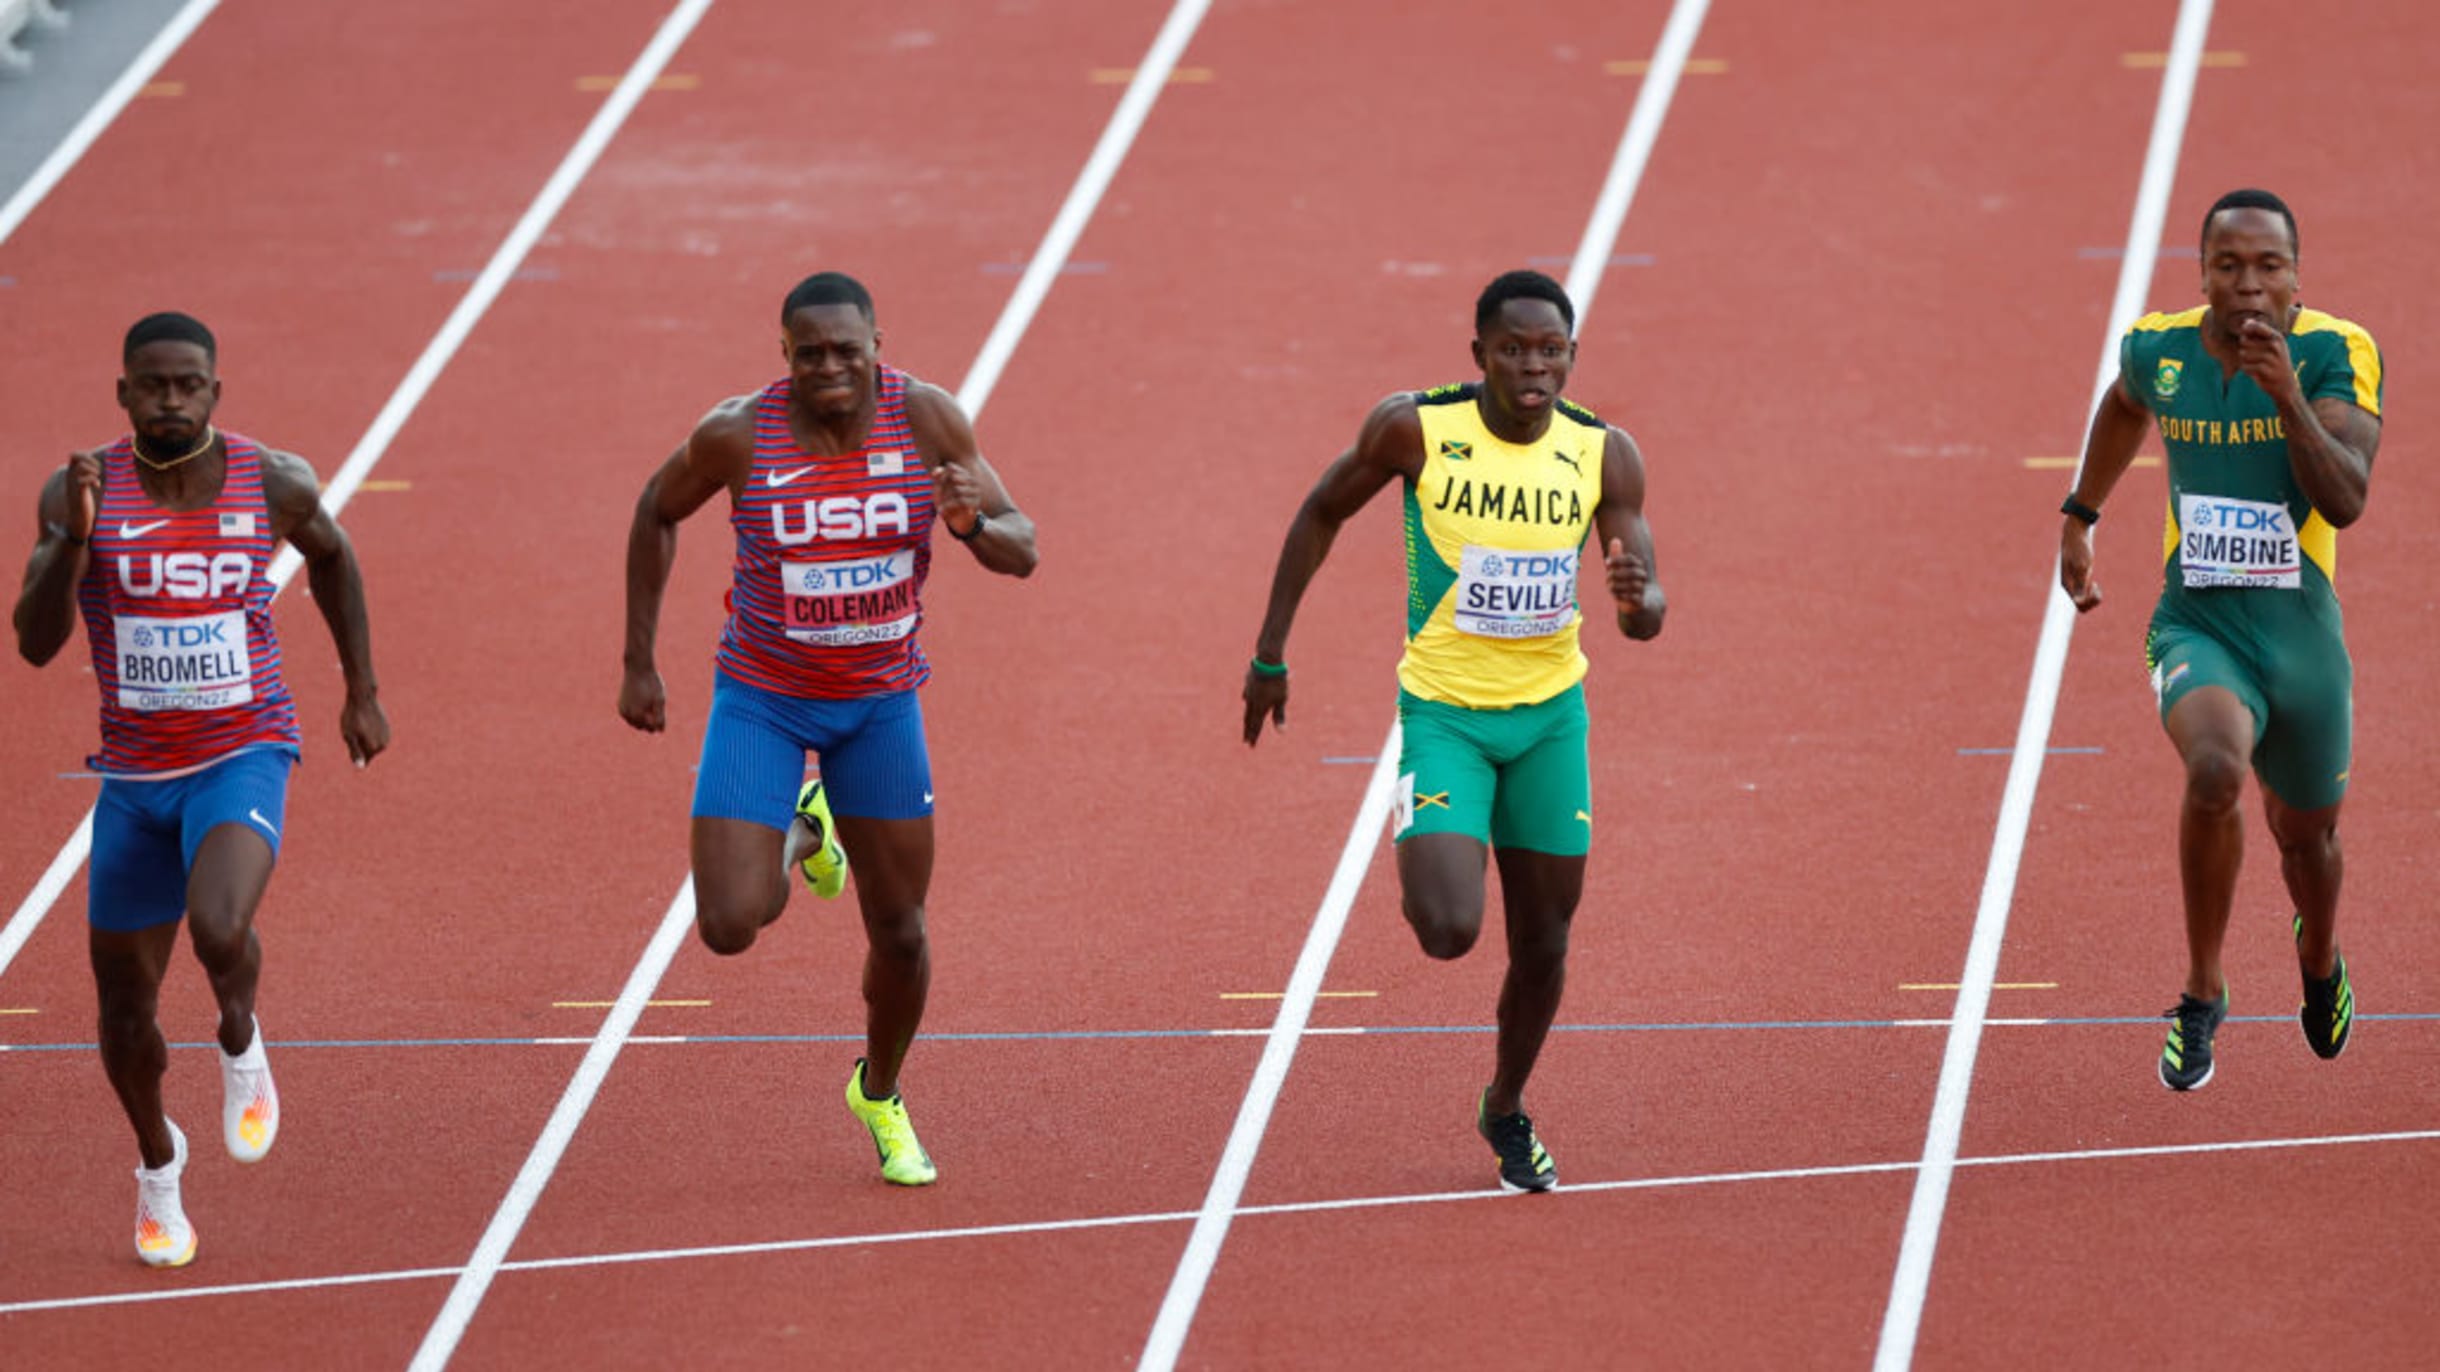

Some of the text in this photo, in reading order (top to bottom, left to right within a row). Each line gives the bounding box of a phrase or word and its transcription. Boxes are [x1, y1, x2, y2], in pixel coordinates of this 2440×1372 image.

[2160, 416, 2287, 444] SOUTH AFRIC
[1434, 476, 1582, 526] JAMAICA
[771, 492, 909, 545] USA
[2213, 504, 2284, 533] TDK
[2186, 532, 2294, 565] SIMBINE
[118, 552, 253, 599] USA
[827, 557, 896, 589] TDK
[1505, 554, 1573, 577] TDK
[794, 582, 908, 624] COLEMAN
[154, 619, 226, 648] TDK
[809, 623, 902, 645] OREGON22
[124, 650, 243, 683] BROMELL
